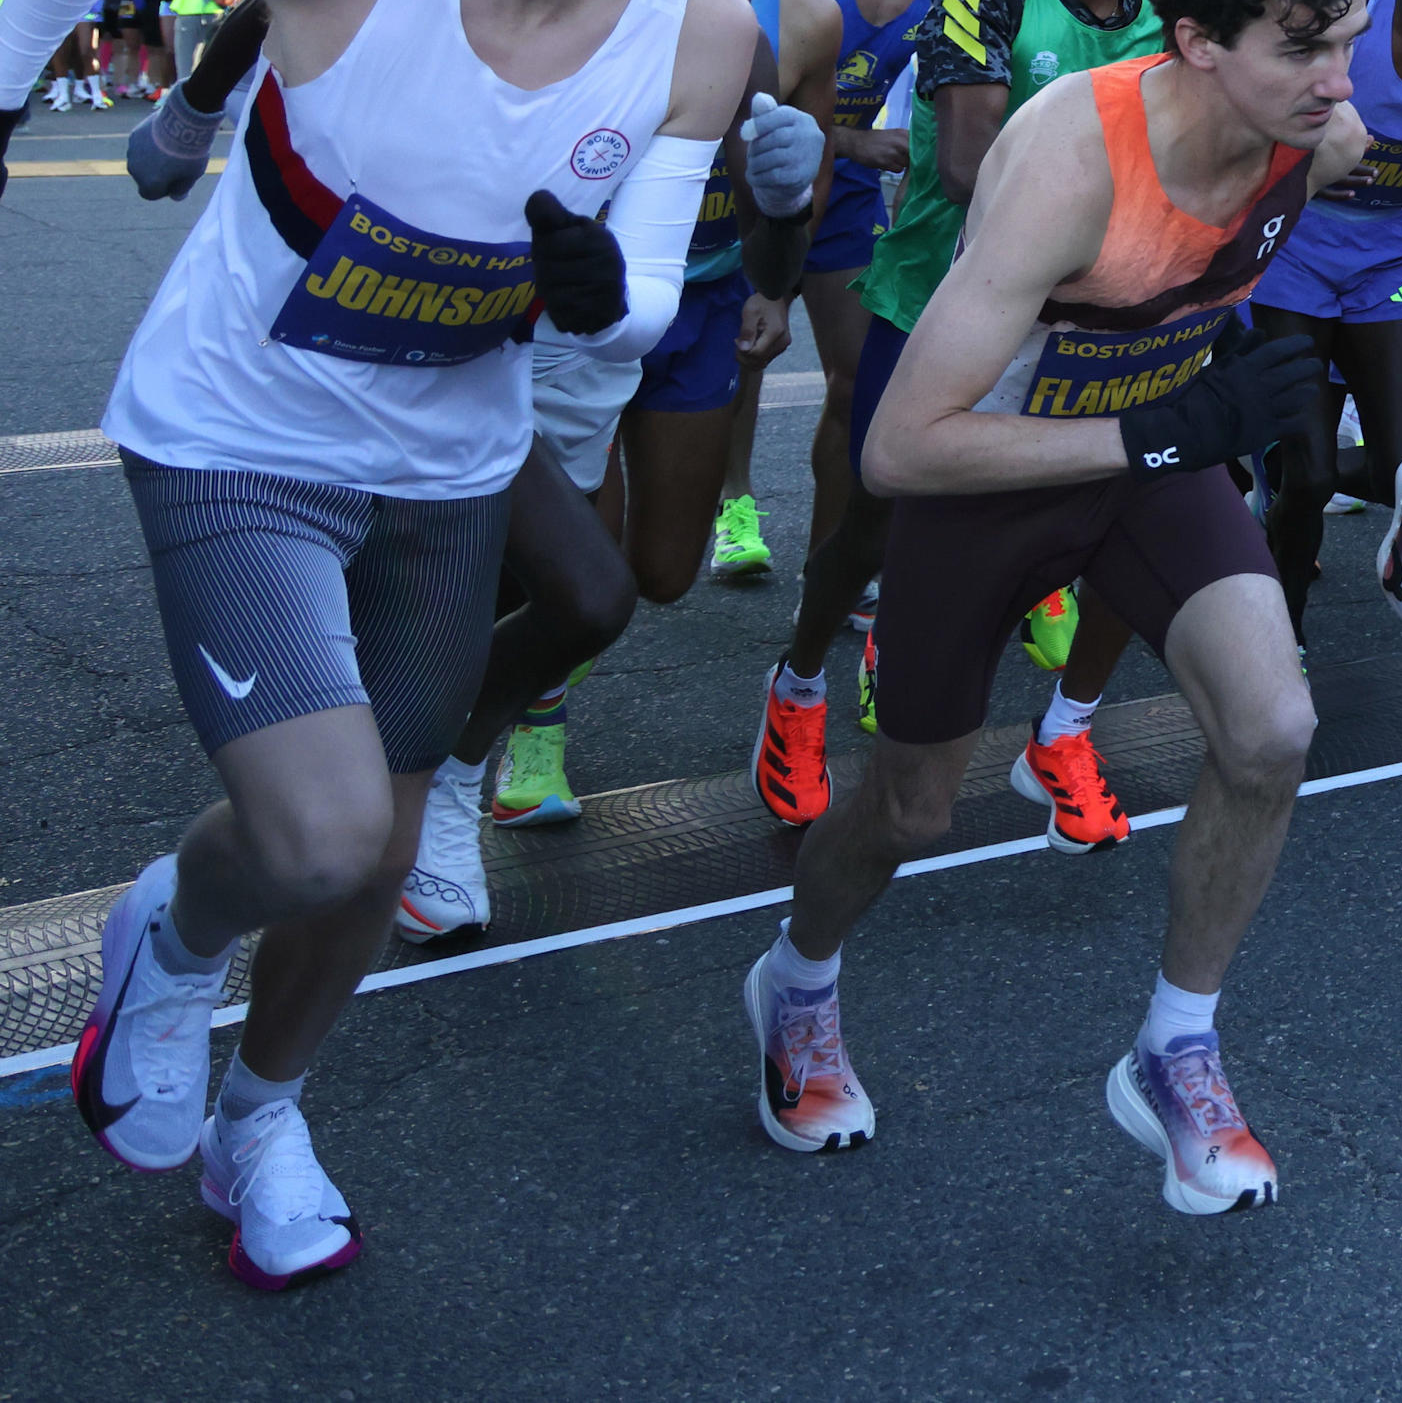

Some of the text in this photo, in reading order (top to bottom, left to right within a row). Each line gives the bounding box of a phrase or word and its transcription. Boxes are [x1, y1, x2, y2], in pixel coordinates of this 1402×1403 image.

[349, 211, 533, 271] BOSTON HA
[305, 255, 536, 326] JOHNSON
[1057, 311, 1228, 359] BOSTON HALF
